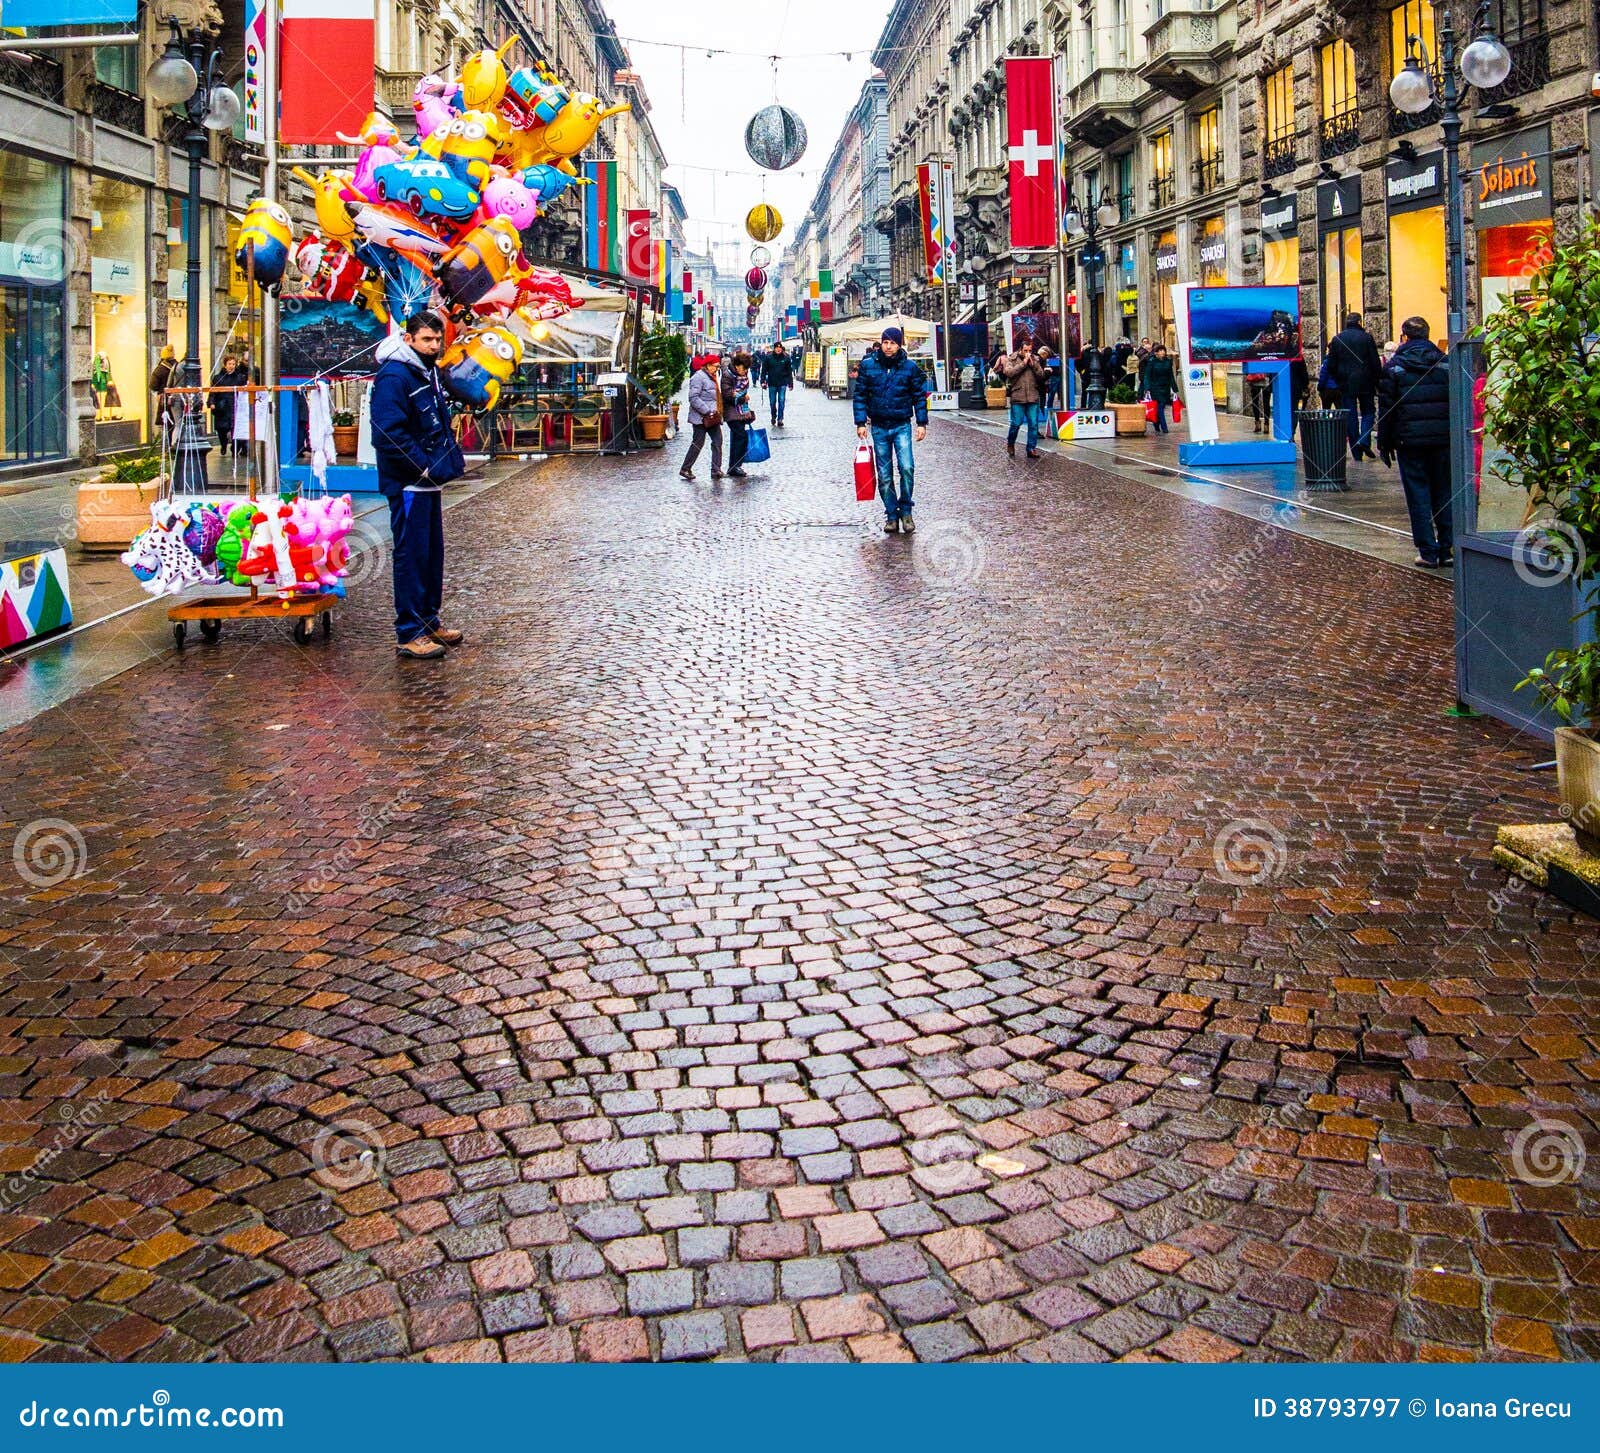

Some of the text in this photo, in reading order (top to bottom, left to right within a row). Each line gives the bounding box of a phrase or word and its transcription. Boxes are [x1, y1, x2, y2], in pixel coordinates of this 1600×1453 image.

[246, 44, 258, 132] EXPO
[1479, 151, 1537, 201] Solaris
[1077, 414, 1110, 425] EXPO
